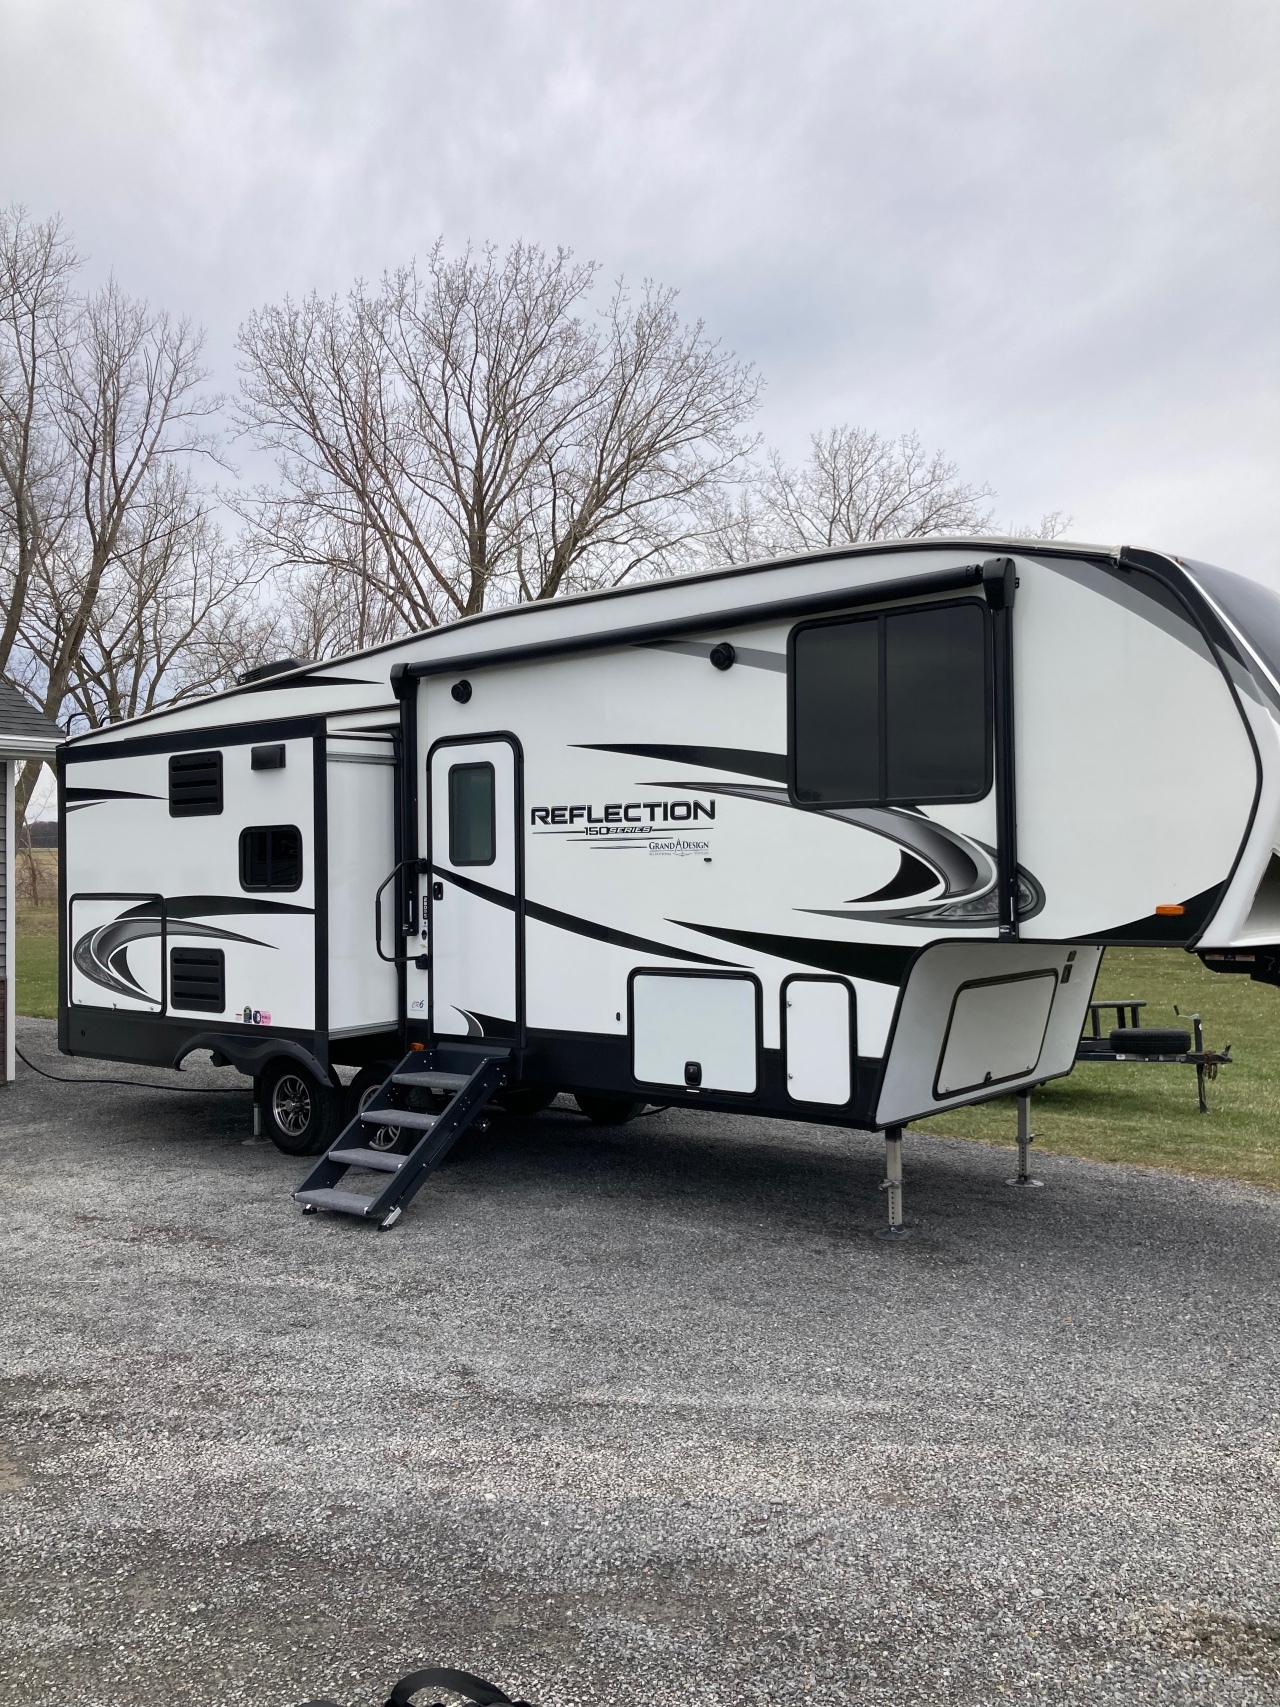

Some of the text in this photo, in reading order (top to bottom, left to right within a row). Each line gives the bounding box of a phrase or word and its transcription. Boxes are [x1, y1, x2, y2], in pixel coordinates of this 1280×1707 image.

[530, 799, 716, 826] REFLECTION
[584, 825, 653, 836] 150 SERIES
[649, 840, 709, 850] GRAND DESIGN
